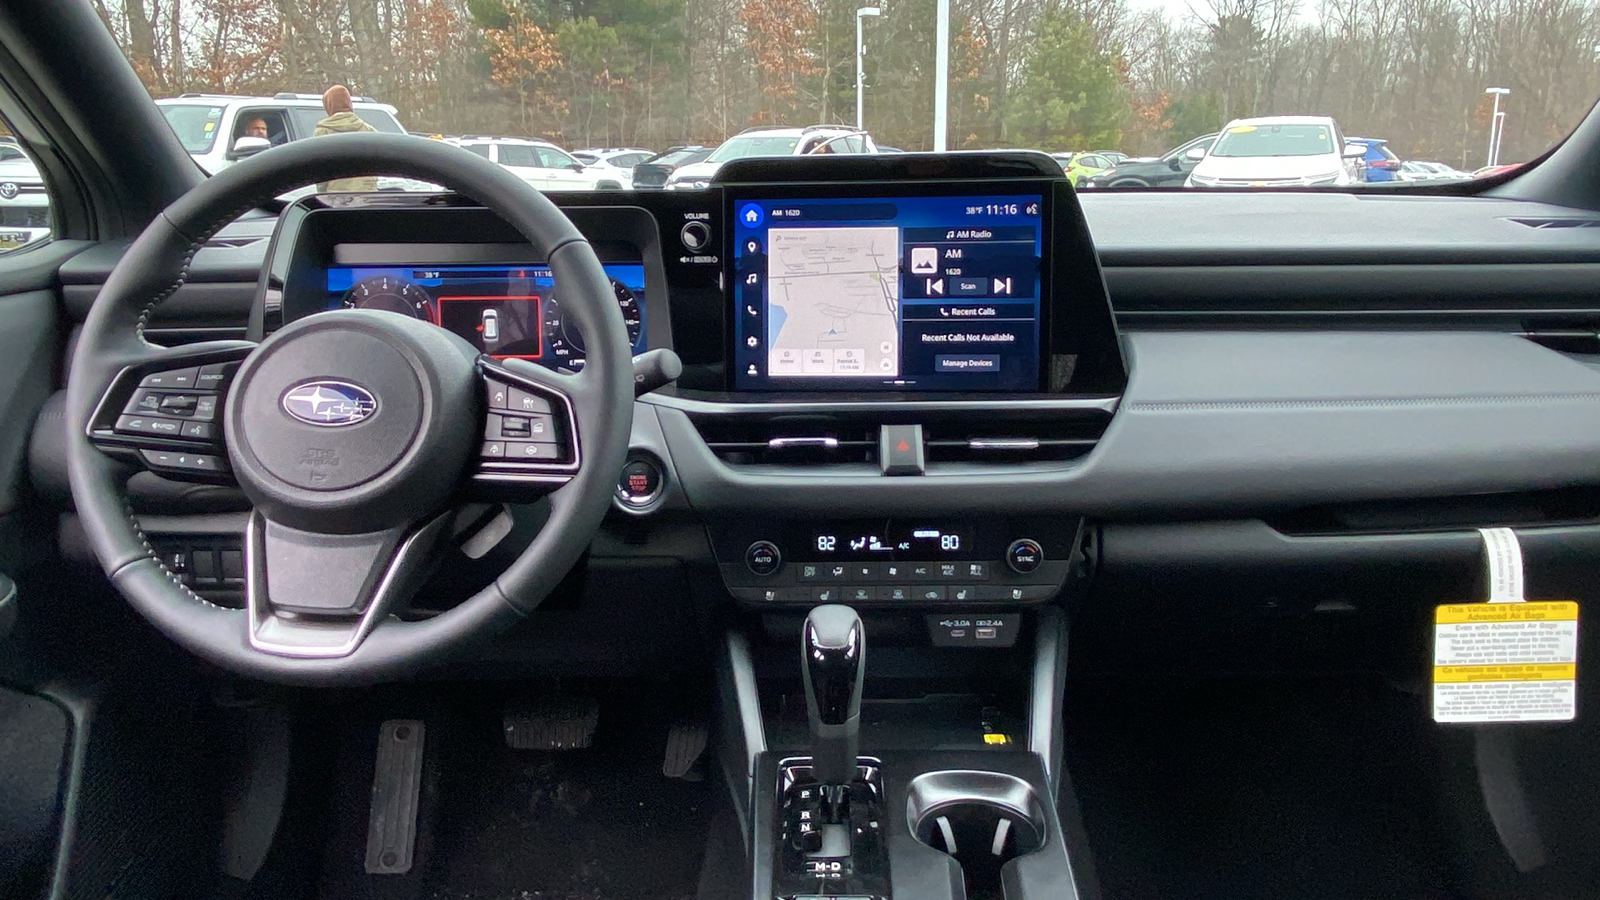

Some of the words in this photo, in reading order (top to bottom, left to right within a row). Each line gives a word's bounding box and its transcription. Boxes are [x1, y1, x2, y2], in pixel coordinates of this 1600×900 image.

[986, 204, 1017, 215] 11:16
[971, 230, 992, 238] Radio
[945, 249, 961, 258] AM
[981, 333, 1015, 341] Available
[943, 360, 967, 368] Manage
[818, 536, 836, 550] 82
[941, 535, 959, 549] 80
[1467, 605, 1496, 613] Vehicle
[1510, 604, 1548, 612] Equipped
[1525, 612, 1545, 620] Bags
[801, 824, 810, 832] N
[815, 862, 841, 871] M-D
